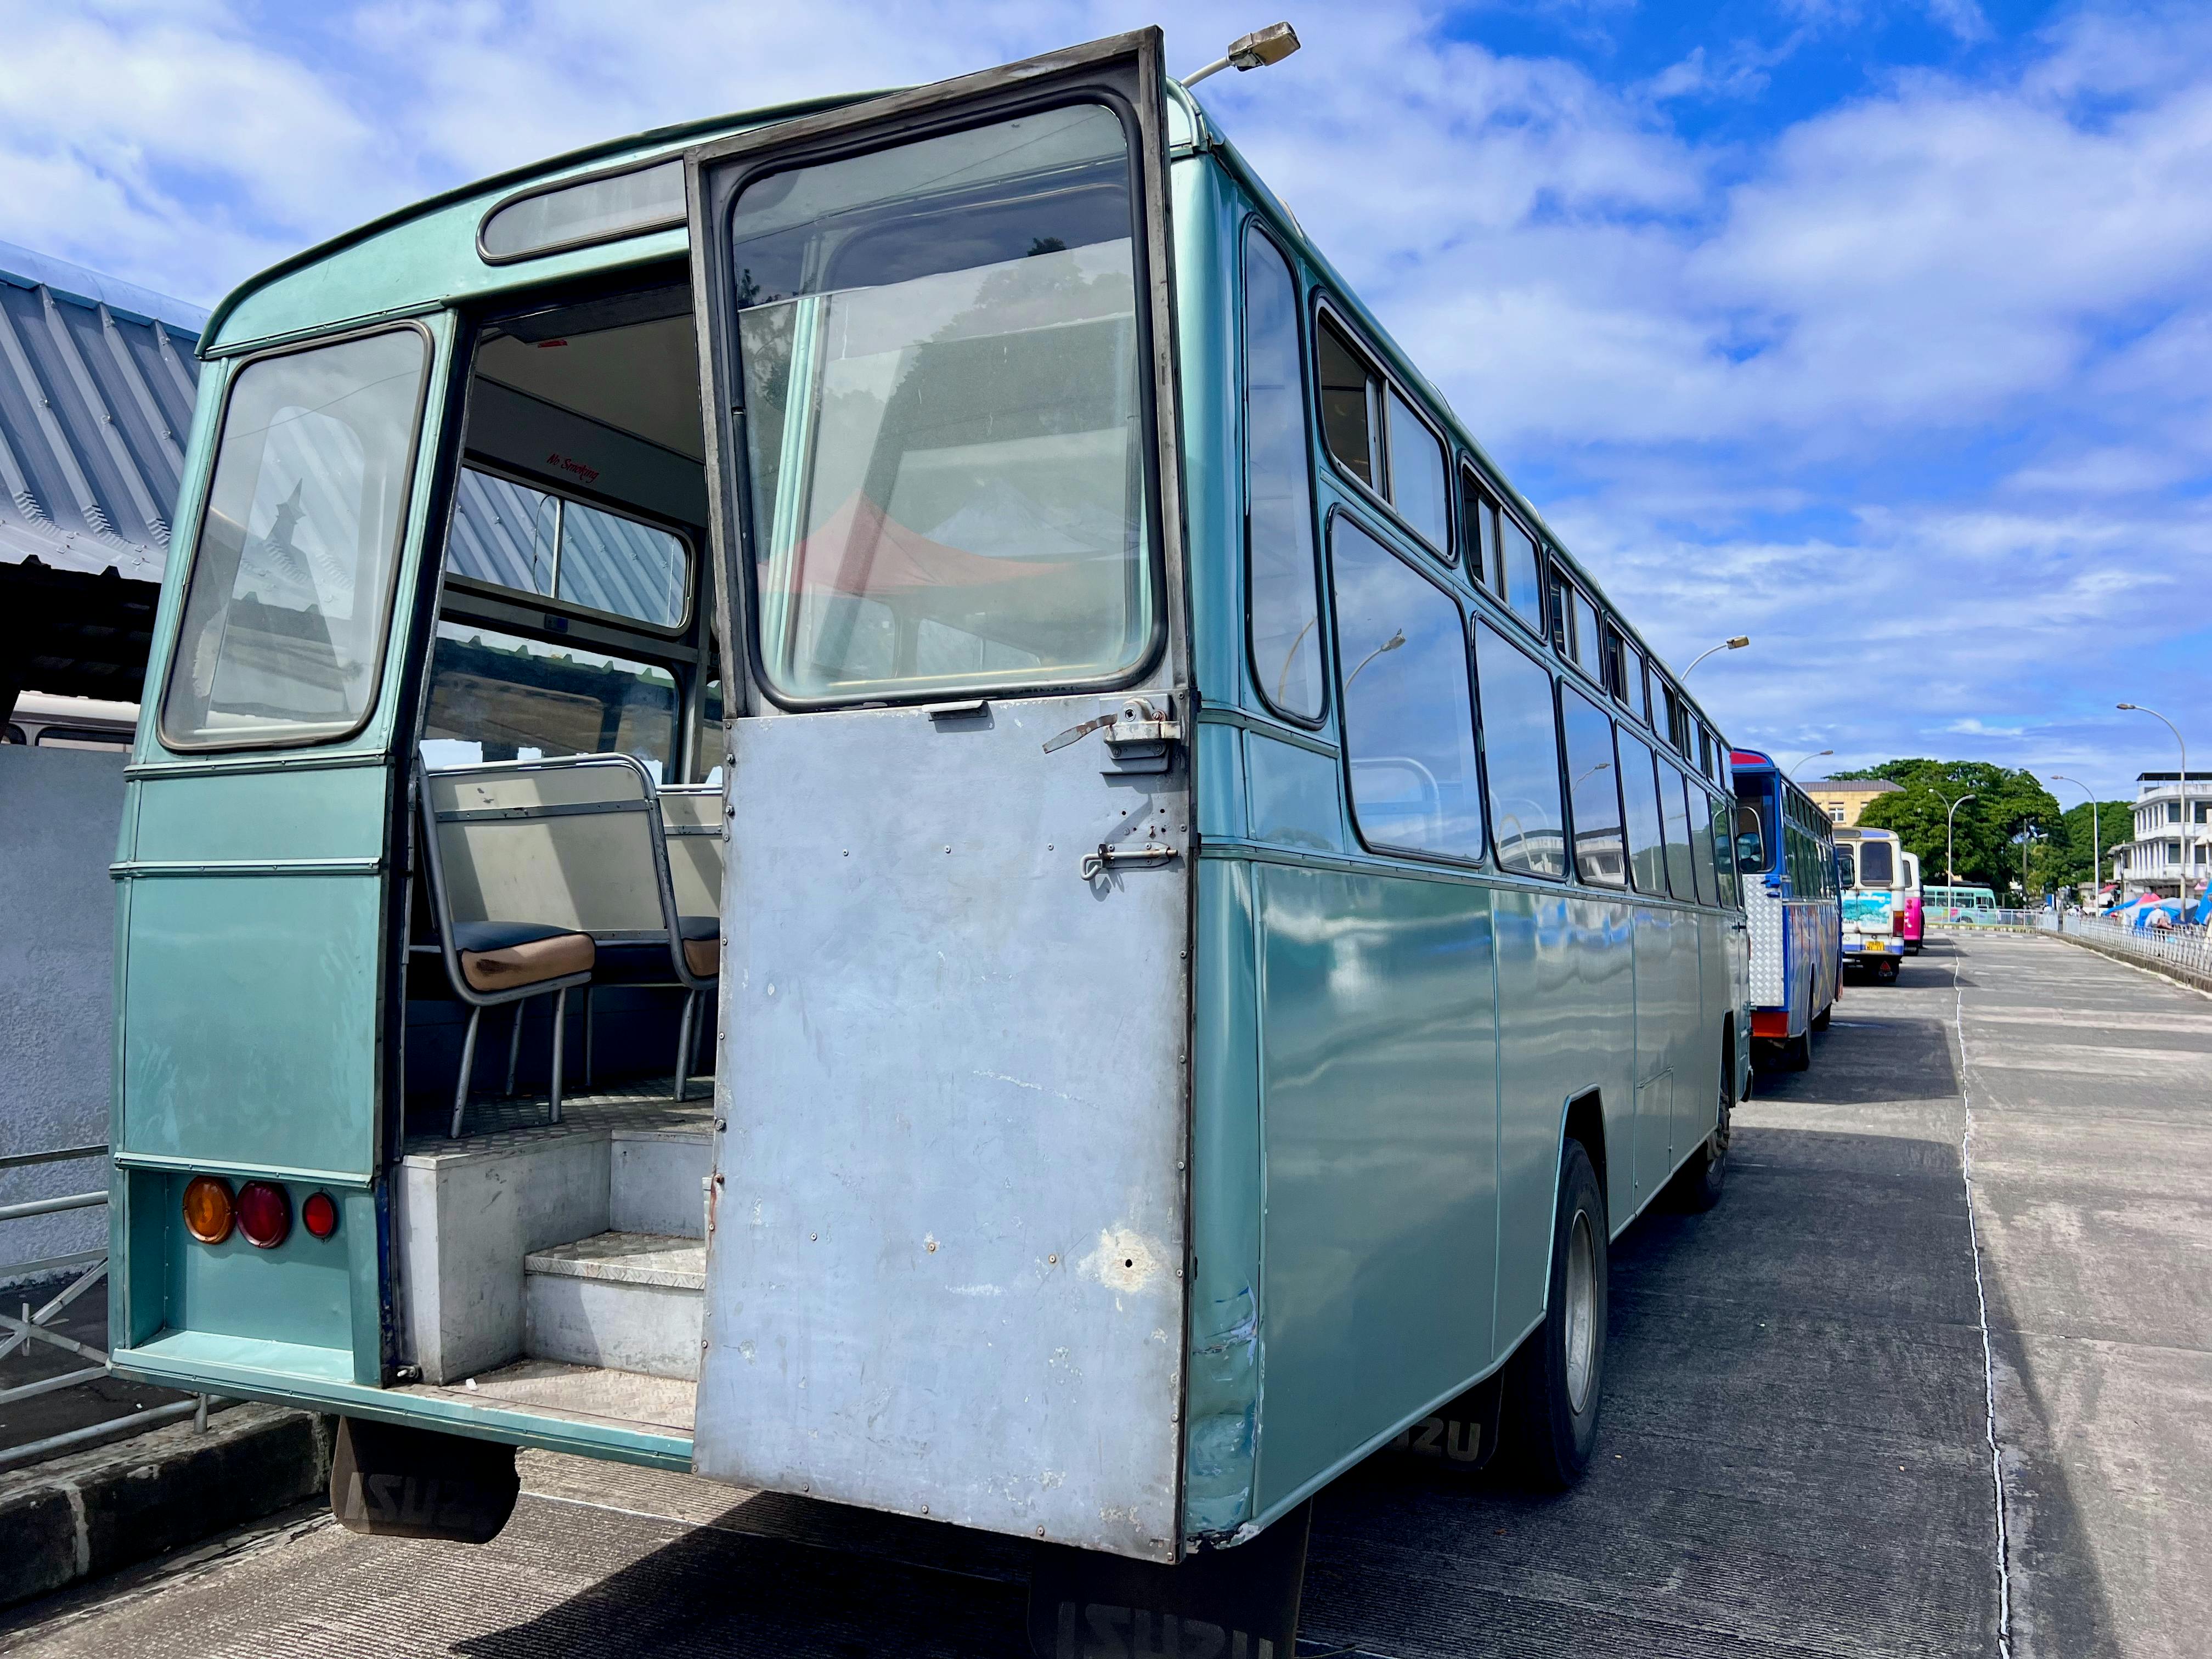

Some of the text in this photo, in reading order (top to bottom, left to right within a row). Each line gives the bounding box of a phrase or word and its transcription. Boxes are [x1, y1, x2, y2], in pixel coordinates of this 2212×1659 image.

[546, 453, 599, 483] No Smoking
[344, 1471, 483, 1527] ISU
